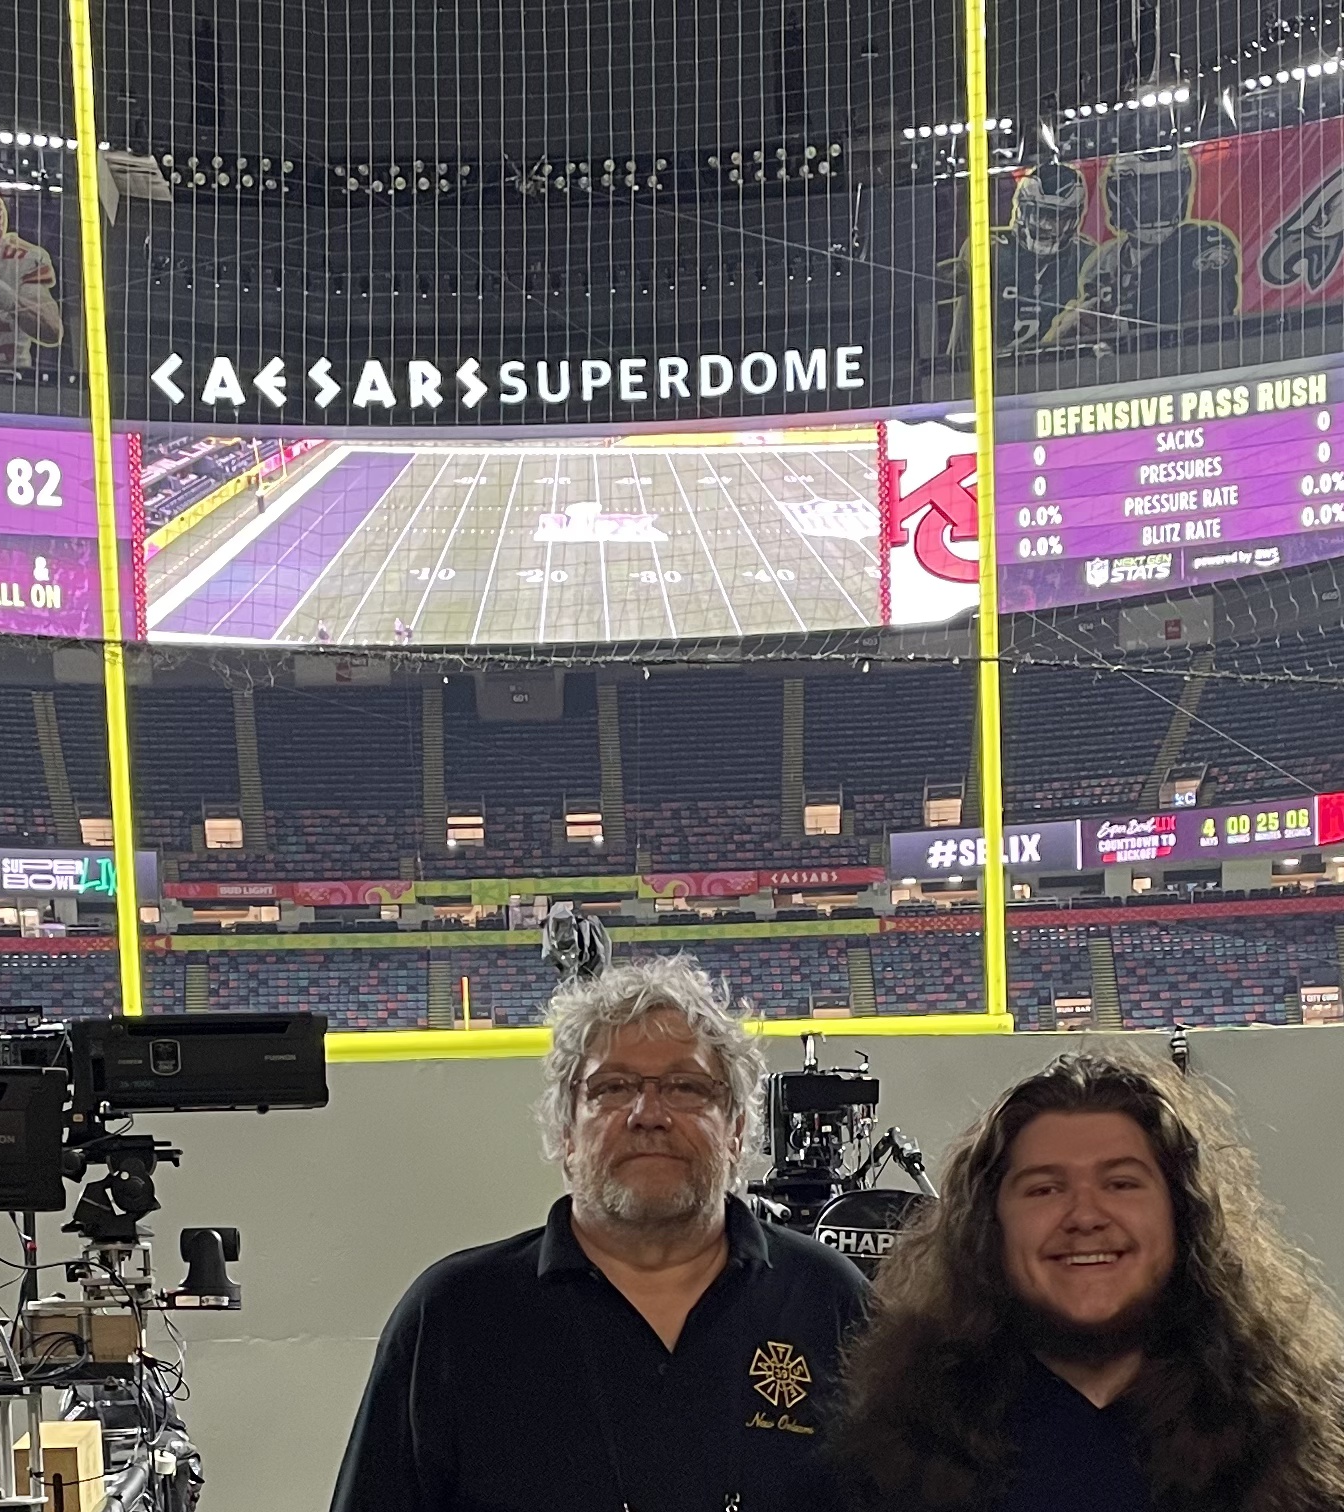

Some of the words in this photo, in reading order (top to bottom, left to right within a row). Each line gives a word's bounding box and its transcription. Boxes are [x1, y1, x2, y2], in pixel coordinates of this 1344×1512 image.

[150, 352, 488, 409] CAESARS
[499, 345, 865, 404] SUPERDOME
[1035, 394, 1174, 439] DEFENSIVE
[1181, 385, 1250, 422] PASS
[1256, 373, 1328, 412] RUSH
[1033, 445, 1047, 466] 0
[1156, 427, 1204, 453] SACKS
[1317, 410, 1331, 432] 0
[6, 456, 63, 507] 82
[1033, 475, 1047, 497] 0
[1140, 456, 1223, 485] PRESSURES
[1317, 441, 1331, 463] 0
[1018, 505, 1063, 528] 0.0%
[1124, 488, 1198, 518] PRESSURE
[1202, 485, 1239, 508] RATE
[1018, 536, 1064, 559] 0.0%
[1142, 522, 1181, 547] BLITZ
[1185, 517, 1222, 540] RATE
[32, 556, 50, 582] &
[1110, 563, 1172, 583] STATS
[30, 583, 62, 609] ON
[512, 694, 529, 703] 601
[1202, 818, 1216, 837] 4
[1226, 814, 1251, 834] 00
[1256, 811, 1280, 832] 25
[1286, 808, 1309, 829] 06
[1097, 835, 1159, 853] COUNTDOWN
[1160, 832, 1177, 848] TO
[1, 858, 84, 875] SUPER
[2, 873, 85, 890] BOWL
[219, 886, 242, 895] BUD
[243, 886, 274, 895] LIGHT
[819, 1230, 896, 1255] CHAP
